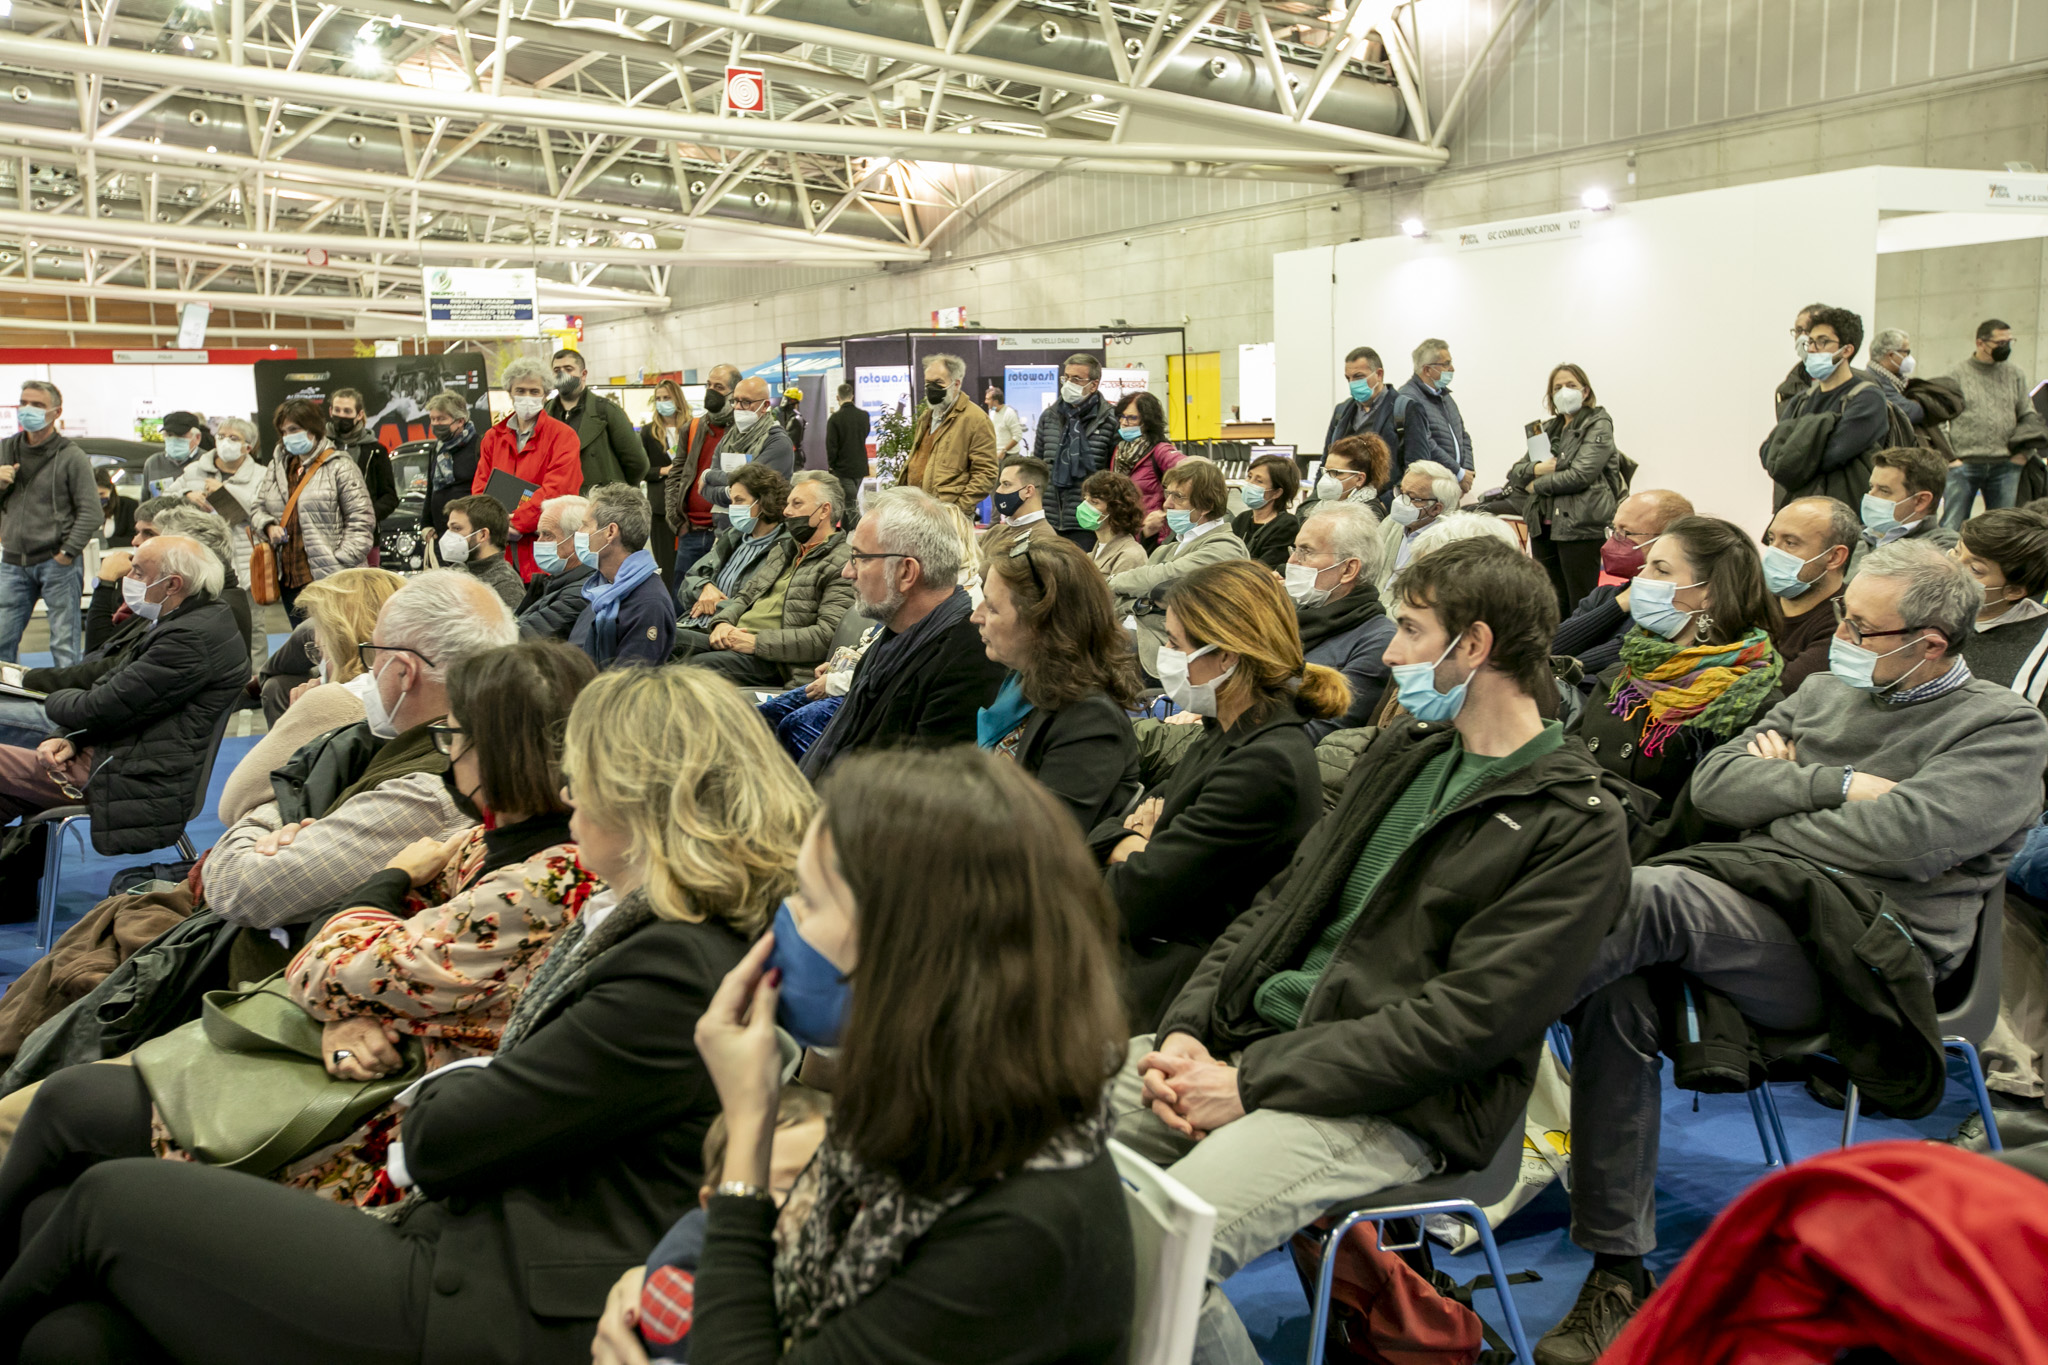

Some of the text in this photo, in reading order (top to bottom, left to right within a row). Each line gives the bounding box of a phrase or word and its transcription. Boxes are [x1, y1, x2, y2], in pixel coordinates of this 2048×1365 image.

[1487, 231, 1497, 240] GC
[1498, 223, 1561, 240] COMMUNICATION
[1031, 337, 1056, 345] NOVELLI
[859, 373, 910, 384] rotowash
[1008, 370, 1055, 382] rotowash
